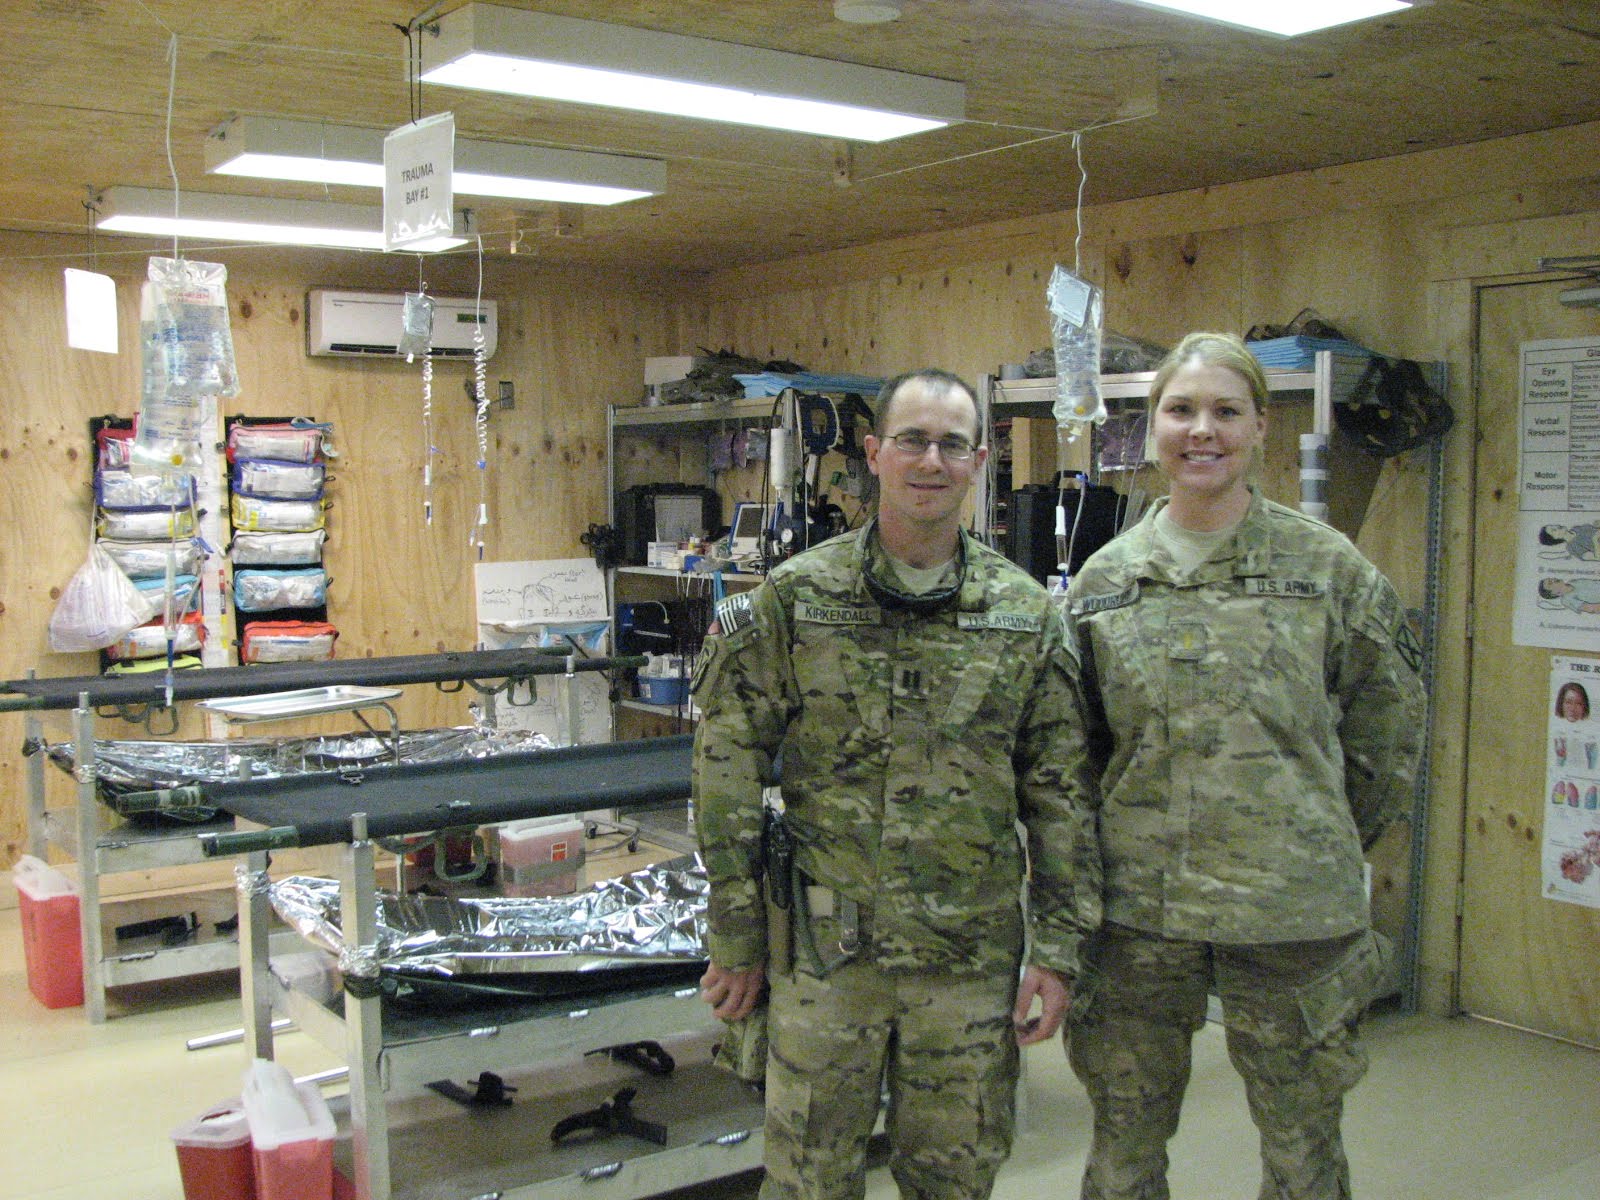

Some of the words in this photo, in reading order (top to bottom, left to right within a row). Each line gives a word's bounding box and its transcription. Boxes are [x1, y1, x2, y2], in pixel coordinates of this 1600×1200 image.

[401, 163, 434, 183] TRAUMA
[406, 192, 419, 204] BAY
[420, 187, 429, 200] #1
[1542, 367, 1557, 377] Eye
[1532, 378, 1566, 388] Opening
[1528, 390, 1569, 399] Response
[1534, 417, 1560, 426] Verbal
[1527, 429, 1567, 438] Response
[1534, 471, 1558, 480] Motor
[1526, 482, 1565, 491] Response
[1257, 579, 1281, 594] U.S.
[1284, 580, 1317, 595] ARMY
[805, 605, 872, 622] KIRKENDALL
[994, 615, 1029, 629] ARMY
[1570, 663, 1591, 672] THE
